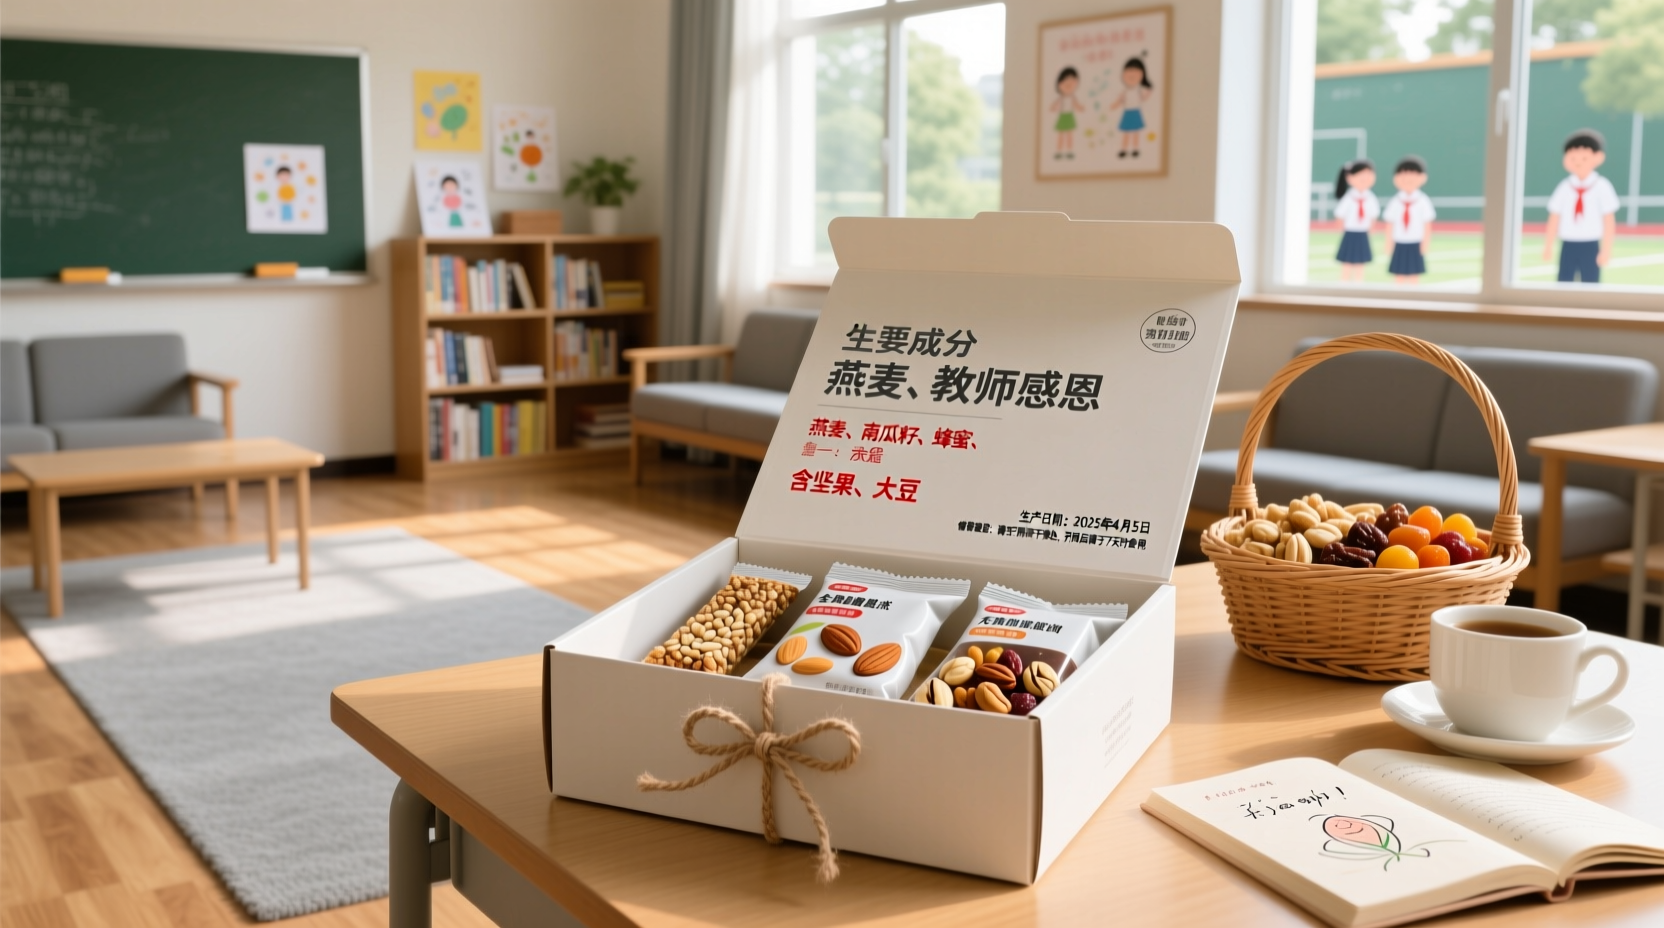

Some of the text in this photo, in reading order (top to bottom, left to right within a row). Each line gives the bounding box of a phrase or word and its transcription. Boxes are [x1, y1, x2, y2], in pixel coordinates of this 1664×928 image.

[841, 323, 977, 358] 生要成分
[823, 359, 1104, 412] 燕麦、教师感恩
